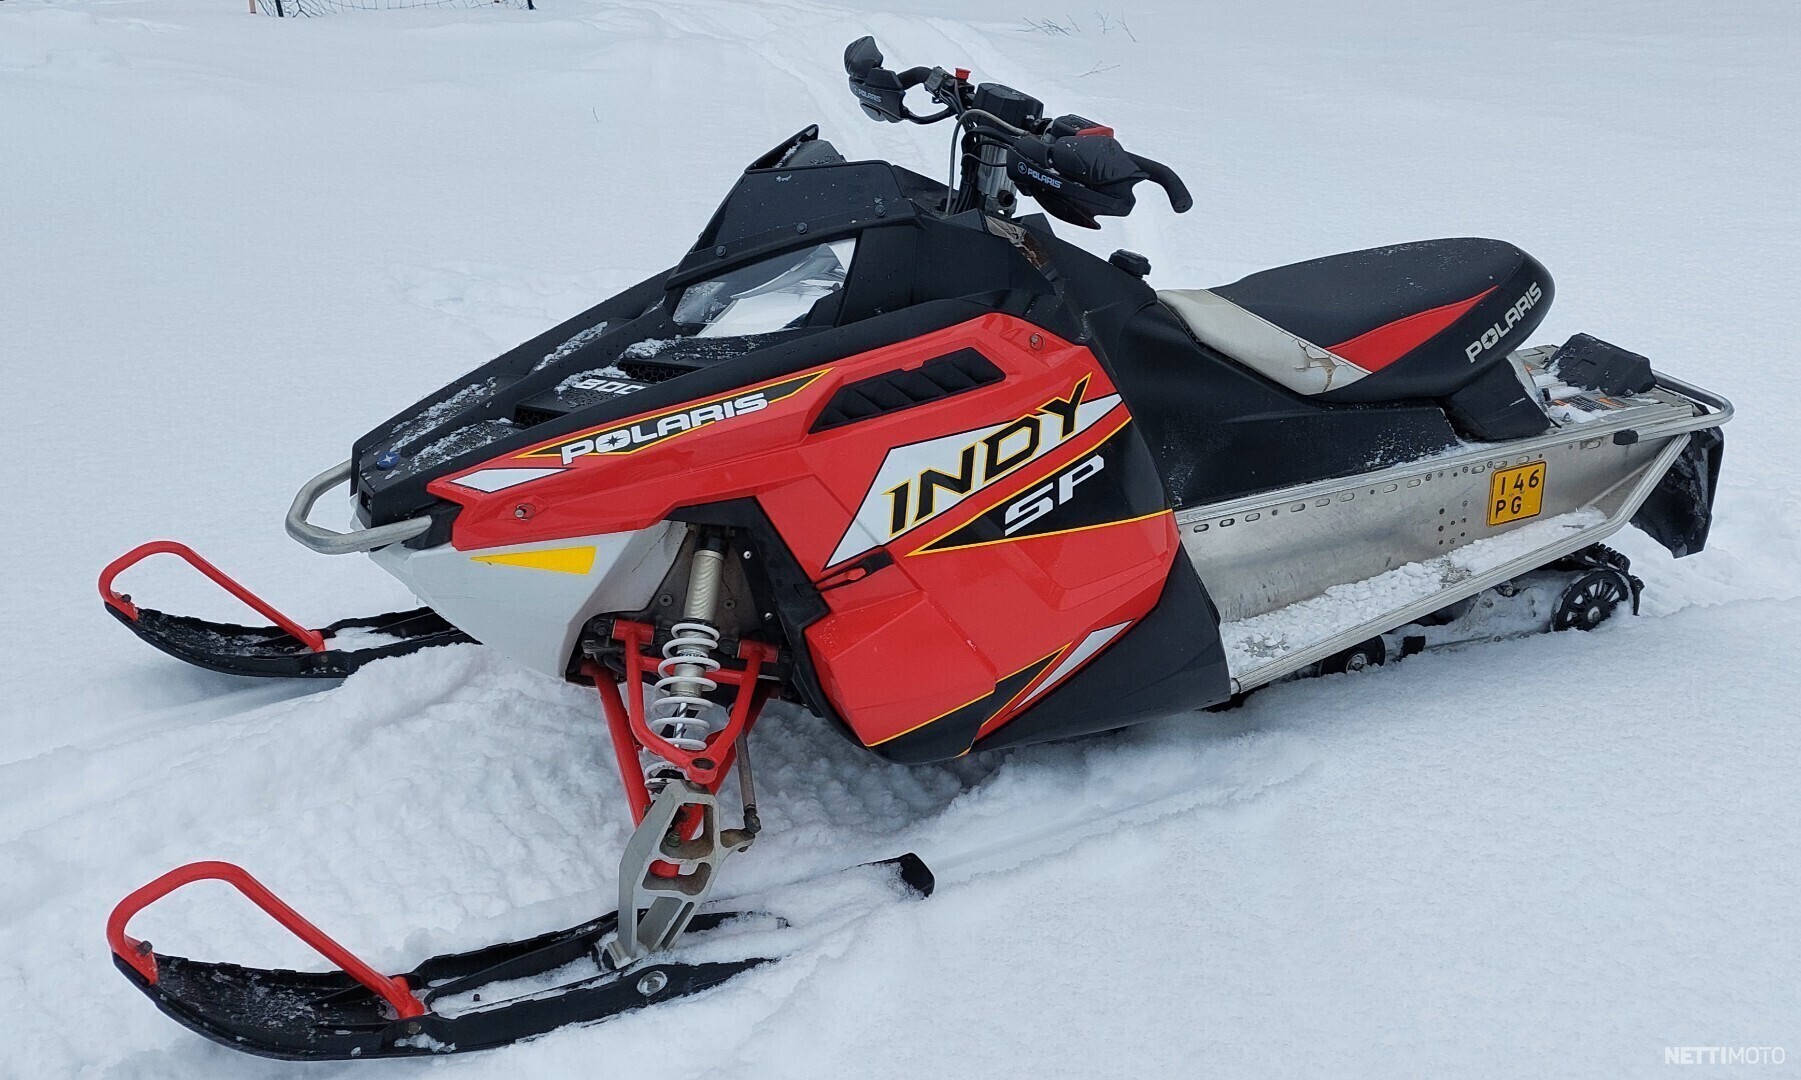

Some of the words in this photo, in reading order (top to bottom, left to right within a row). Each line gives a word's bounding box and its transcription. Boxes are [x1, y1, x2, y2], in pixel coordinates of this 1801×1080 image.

[1027, 167, 1062, 189] POLARIS
[1465, 281, 1542, 364] POLARIS
[561, 391, 769, 466] POLARIS
[881, 371, 1093, 539] INDY
[1004, 454, 1105, 537] SP
[1495, 495, 1522, 519] PG
